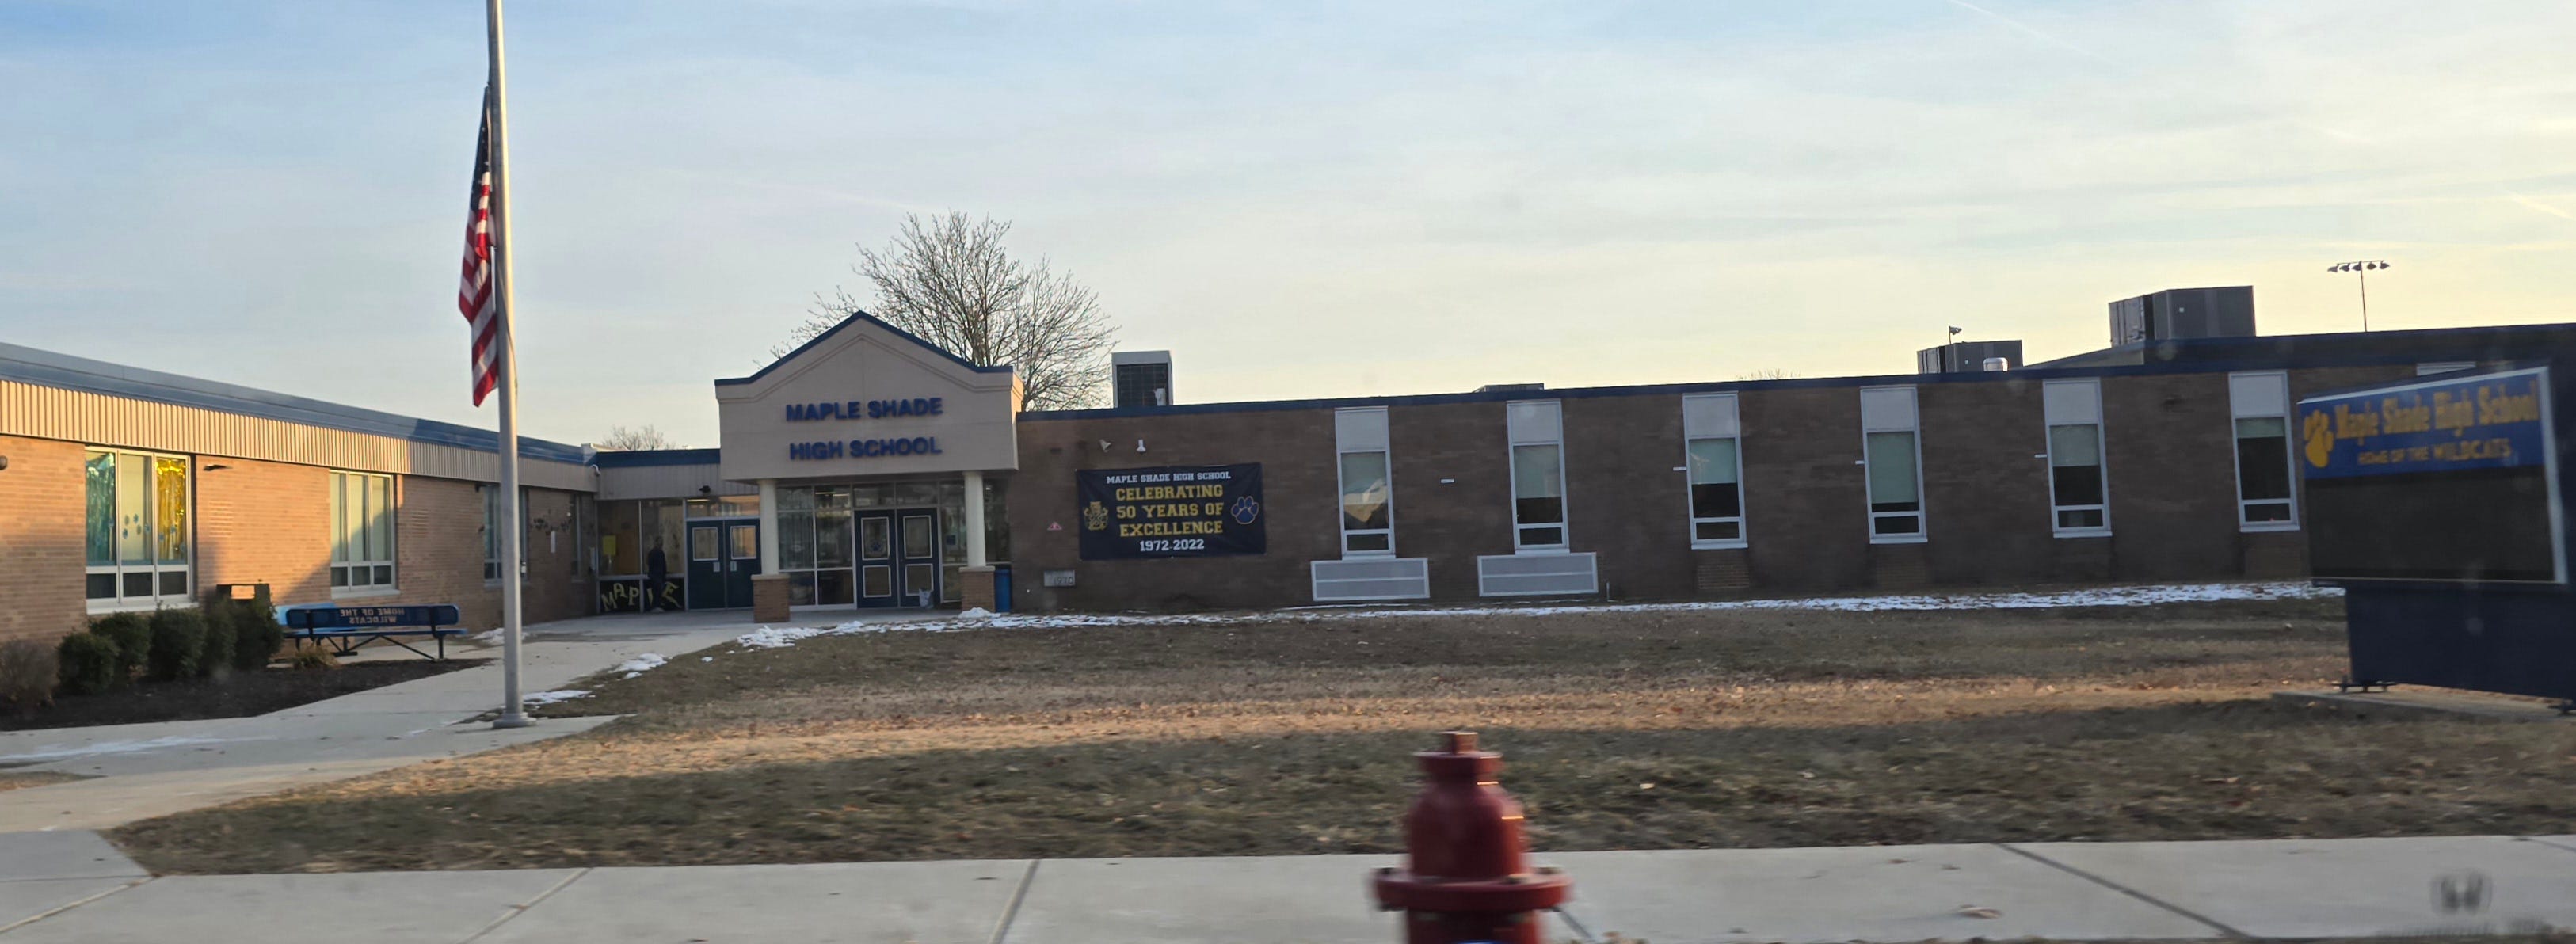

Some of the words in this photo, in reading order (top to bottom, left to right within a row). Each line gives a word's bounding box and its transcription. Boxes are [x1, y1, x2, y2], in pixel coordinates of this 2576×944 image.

[786, 401, 861, 421] MAPLE
[868, 398, 943, 419] SHADE
[2334, 401, 2379, 447] Maple
[2383, 395, 2430, 434] Shade
[2433, 389, 2474, 436] High
[2479, 379, 2540, 425] School
[790, 440, 843, 460] HIGH
[849, 437, 943, 459] SCHOOL
[2434, 439, 2511, 461] WILDCATS
[1107, 474, 1137, 484] MAPLE
[1141, 474, 1170, 482] SHADE
[1173, 473, 1194, 482] HIGH
[1197, 471, 1231, 480] SCHOOL
[1116, 484, 1224, 501] CELEBRATING
[1116, 505, 1136, 519] 50
[1142, 504, 1198, 518] YEARS
[1205, 502, 1224, 516] OF
[1119, 520, 1223, 537] EXCELLENCE
[1140, 539, 1205, 552] 1972-2022
